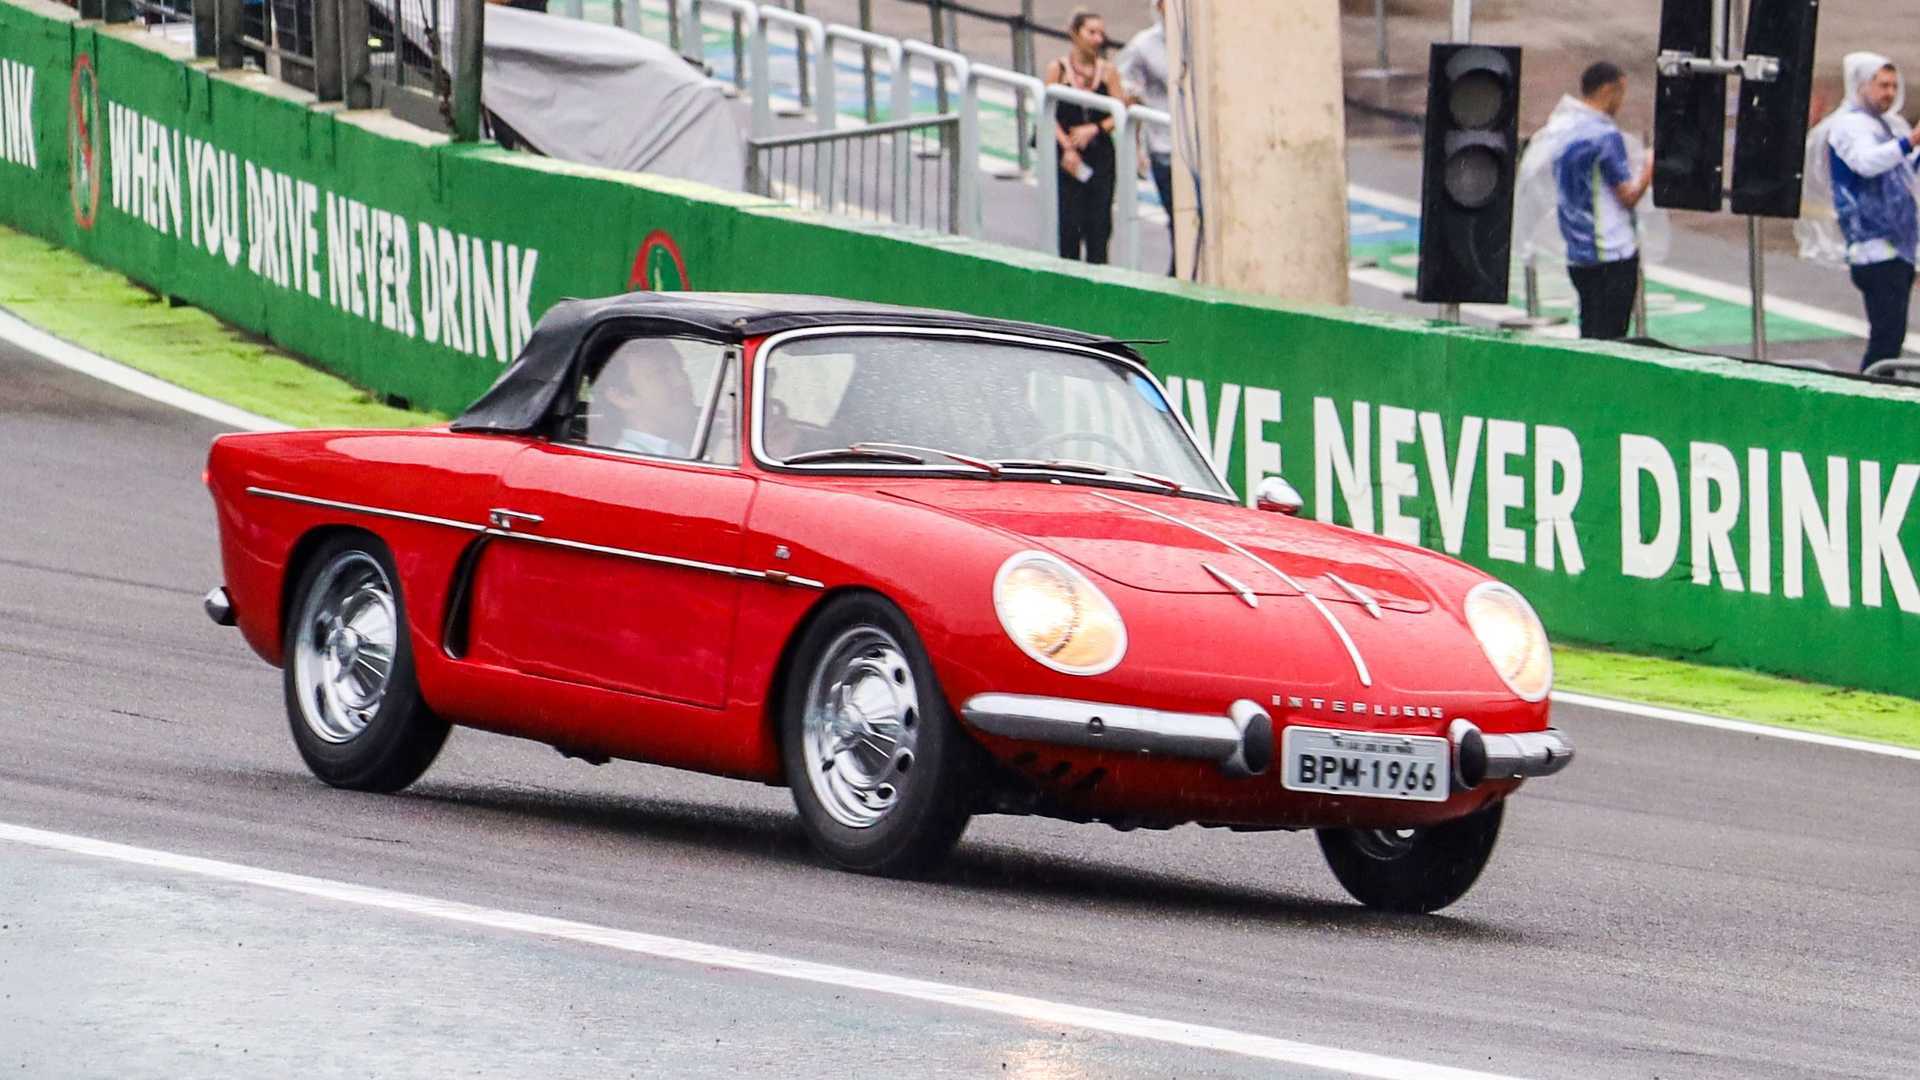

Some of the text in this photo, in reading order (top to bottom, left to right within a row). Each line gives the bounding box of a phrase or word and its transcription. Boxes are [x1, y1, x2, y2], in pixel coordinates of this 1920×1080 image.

[109, 101, 538, 363] WHEN YOU DRIVE NEVER DRINK
[1313, 396, 1585, 575] NEVER
[1619, 433, 1920, 615] DRINK
[1299, 753, 1436, 792] BPM-1966
